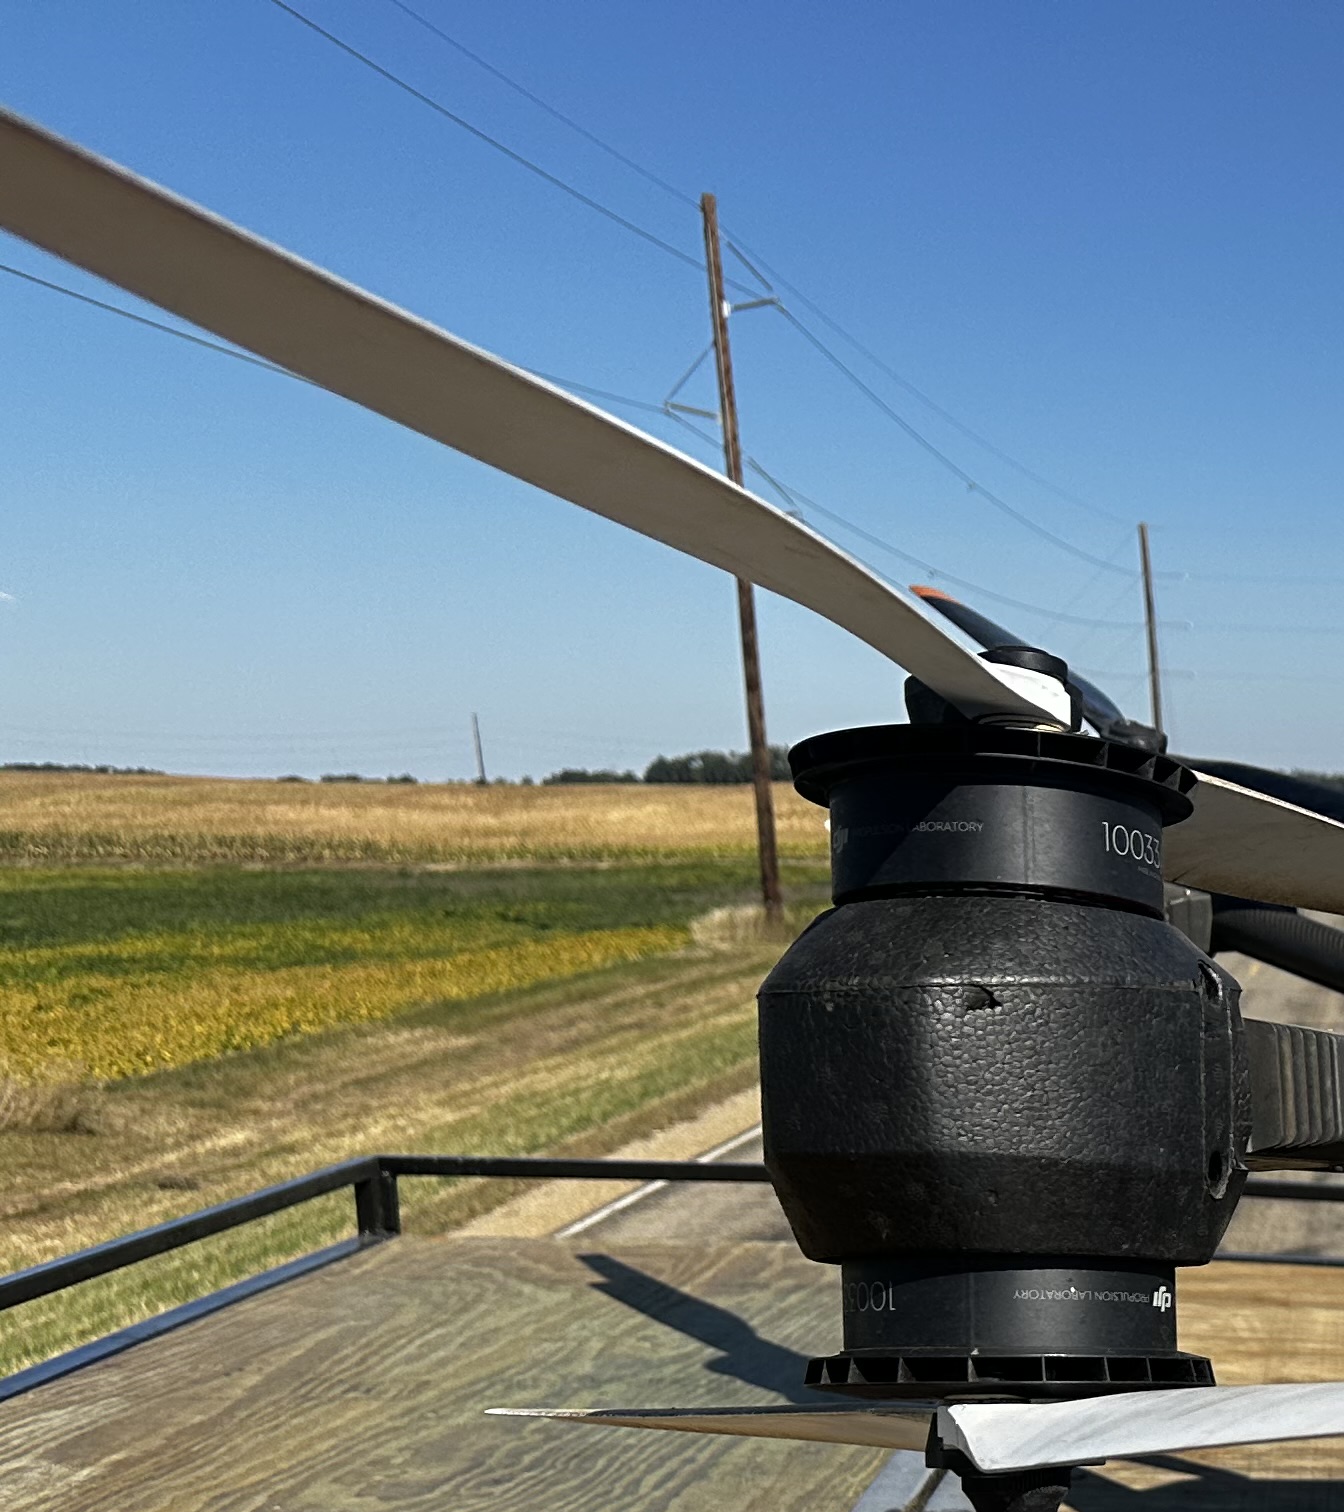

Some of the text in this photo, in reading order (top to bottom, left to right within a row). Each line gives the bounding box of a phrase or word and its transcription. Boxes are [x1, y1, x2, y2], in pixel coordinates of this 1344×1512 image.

[907, 820, 984, 832] LABORATORY
[1102, 821, 1161, 868] 10033
[1013, 1285, 1172, 1313] dji PROPULSION LABORATORY
